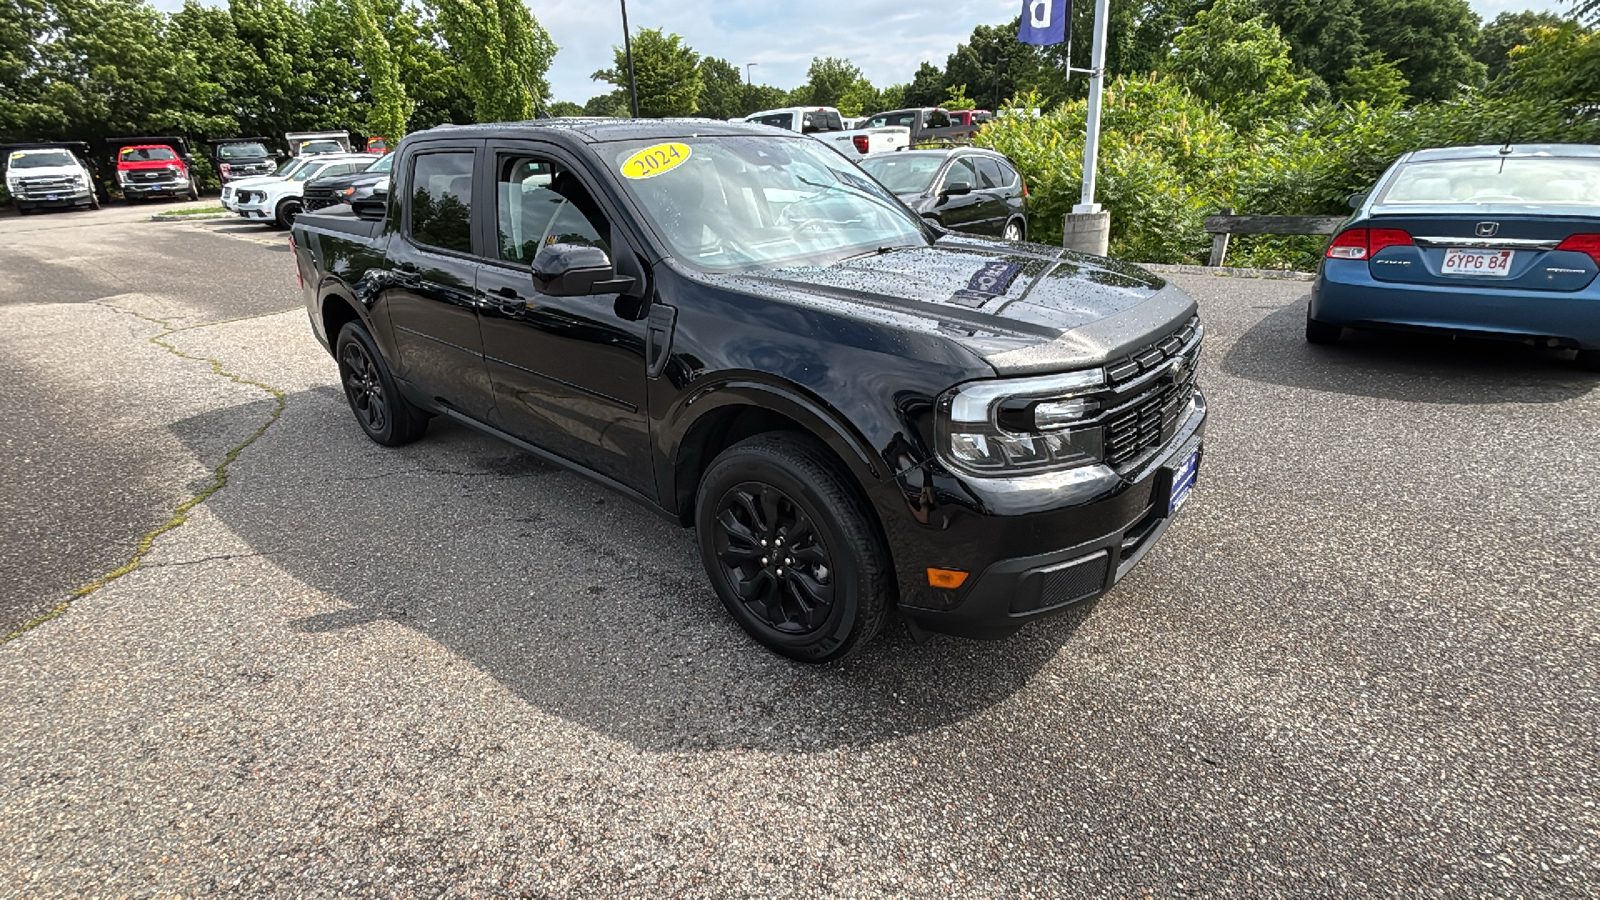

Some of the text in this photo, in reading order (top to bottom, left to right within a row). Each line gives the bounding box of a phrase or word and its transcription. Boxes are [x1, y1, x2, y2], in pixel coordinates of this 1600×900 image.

[633, 145, 680, 175] 2024
[1446, 254, 1508, 270] 6YPG 84
